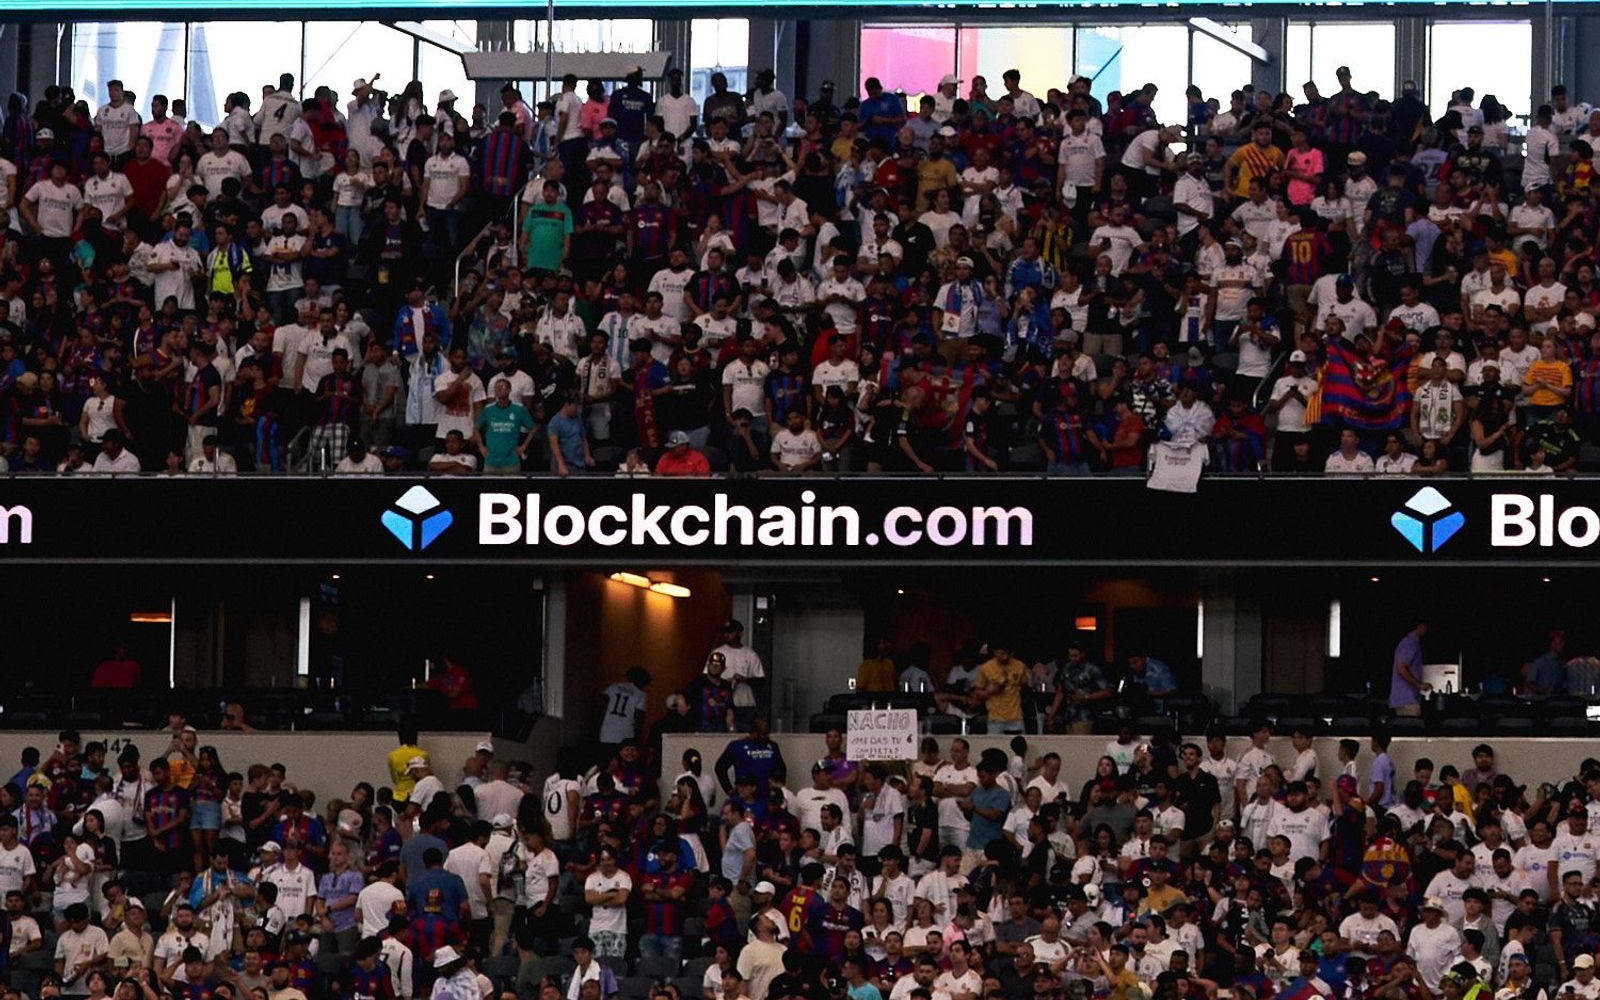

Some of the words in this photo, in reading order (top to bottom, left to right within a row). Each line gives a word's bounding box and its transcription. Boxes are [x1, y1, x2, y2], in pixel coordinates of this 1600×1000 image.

[274, 103, 288, 121] 4
[1293, 240, 1311, 263] 10
[479, 491, 1034, 547] Blockchain.com
[612, 693, 630, 717] 11
[849, 711, 910, 731] NACHO
[790, 906, 803, 931] 6
